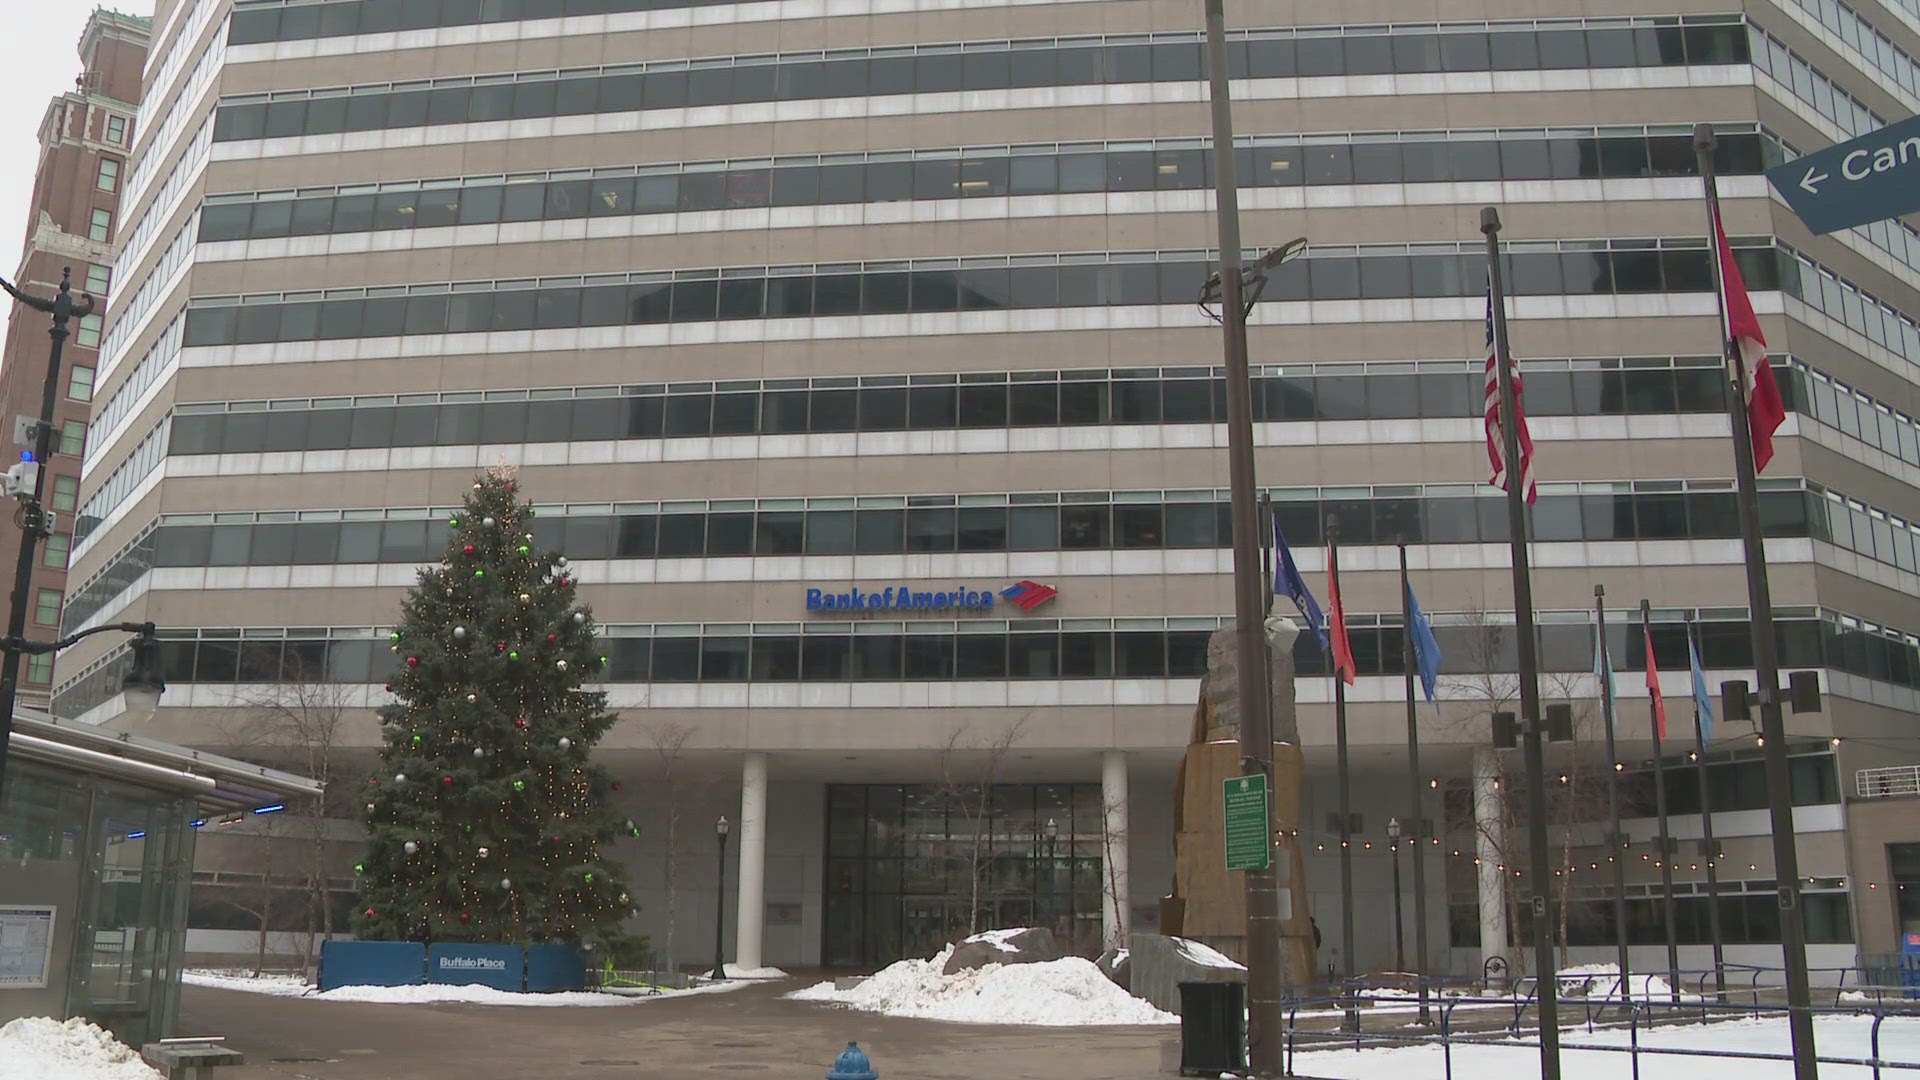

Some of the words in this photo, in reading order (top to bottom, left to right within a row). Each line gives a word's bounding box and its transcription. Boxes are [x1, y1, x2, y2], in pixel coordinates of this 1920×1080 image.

[807, 587, 866, 610] Bank
[868, 587, 893, 610] of
[895, 586, 994, 609] America
[440, 957, 476, 967] Buffalo
[477, 957, 505, 968] Place
